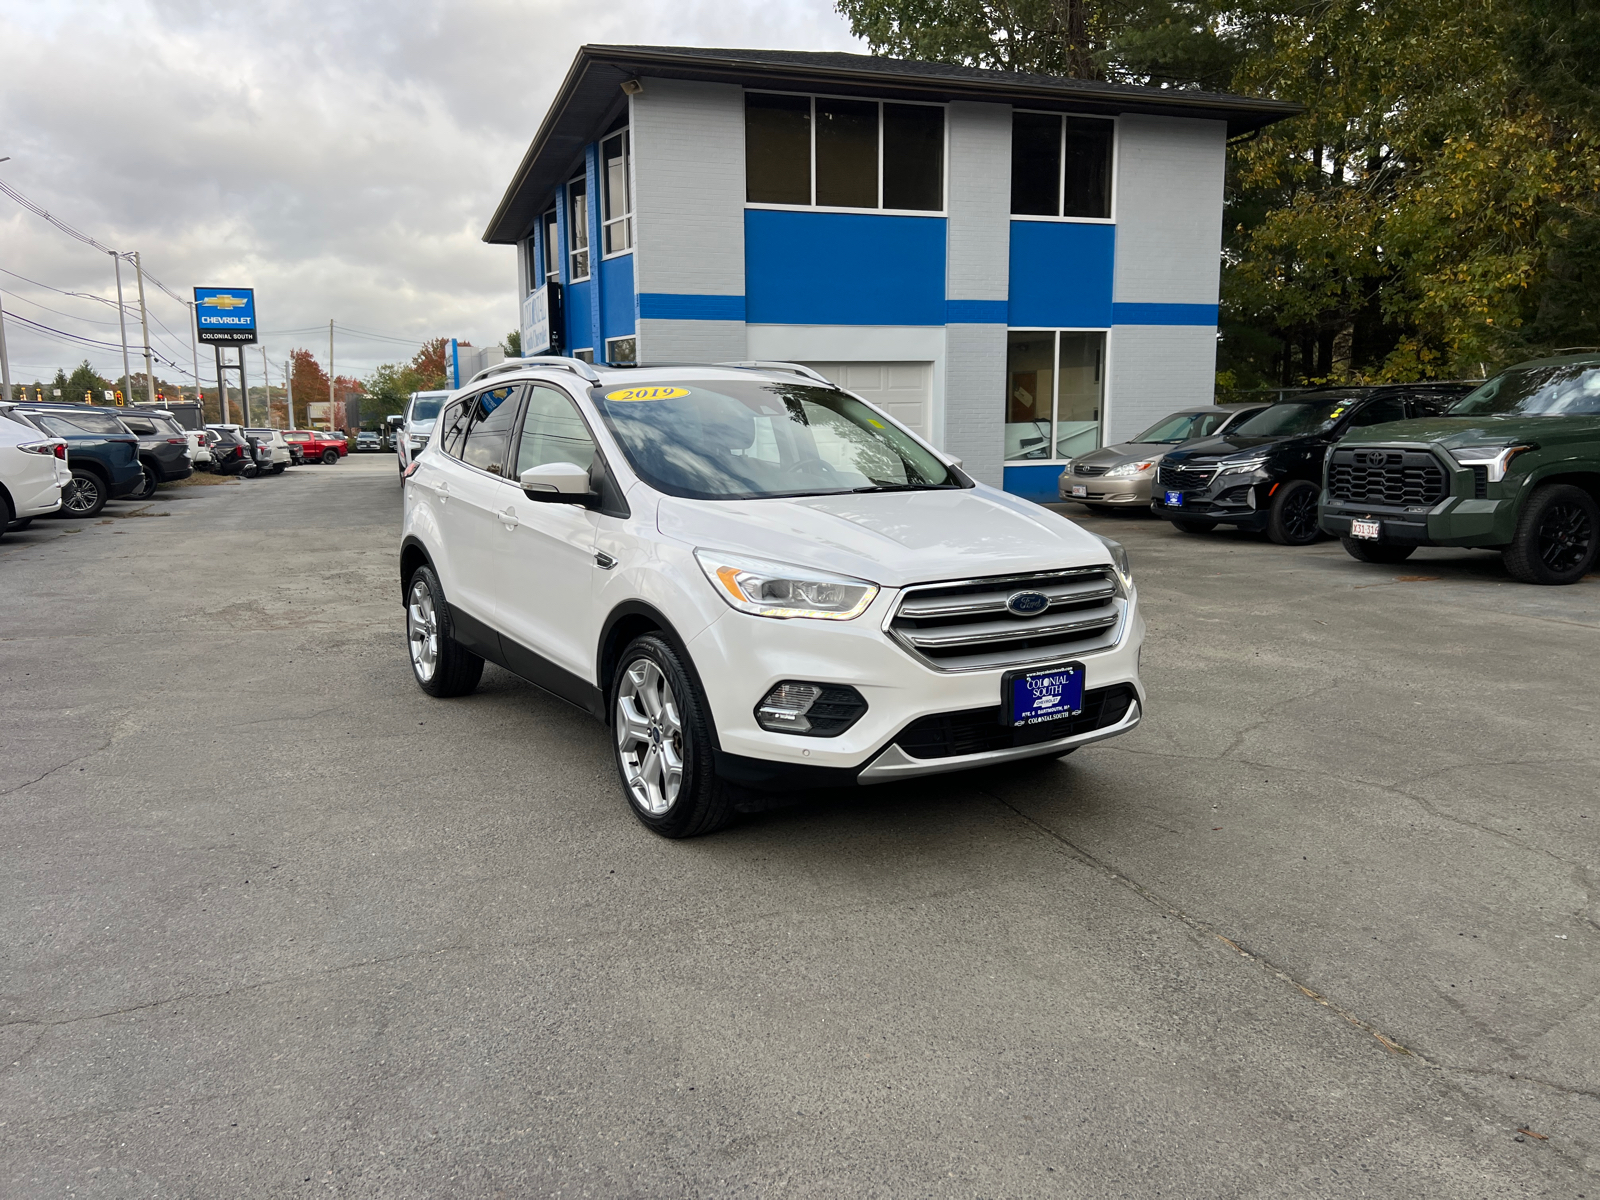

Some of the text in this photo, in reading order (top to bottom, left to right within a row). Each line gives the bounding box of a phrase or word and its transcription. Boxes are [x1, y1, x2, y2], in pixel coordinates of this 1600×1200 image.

[201, 316, 251, 324] CHEVROLET
[622, 388, 674, 400] 2019
[1020, 596, 1042, 609] Ford
[1027, 675, 1069, 689] COLONIAL
[1033, 685, 1062, 697] SOUTH
[1036, 698, 1059, 706] CHEVROLET
